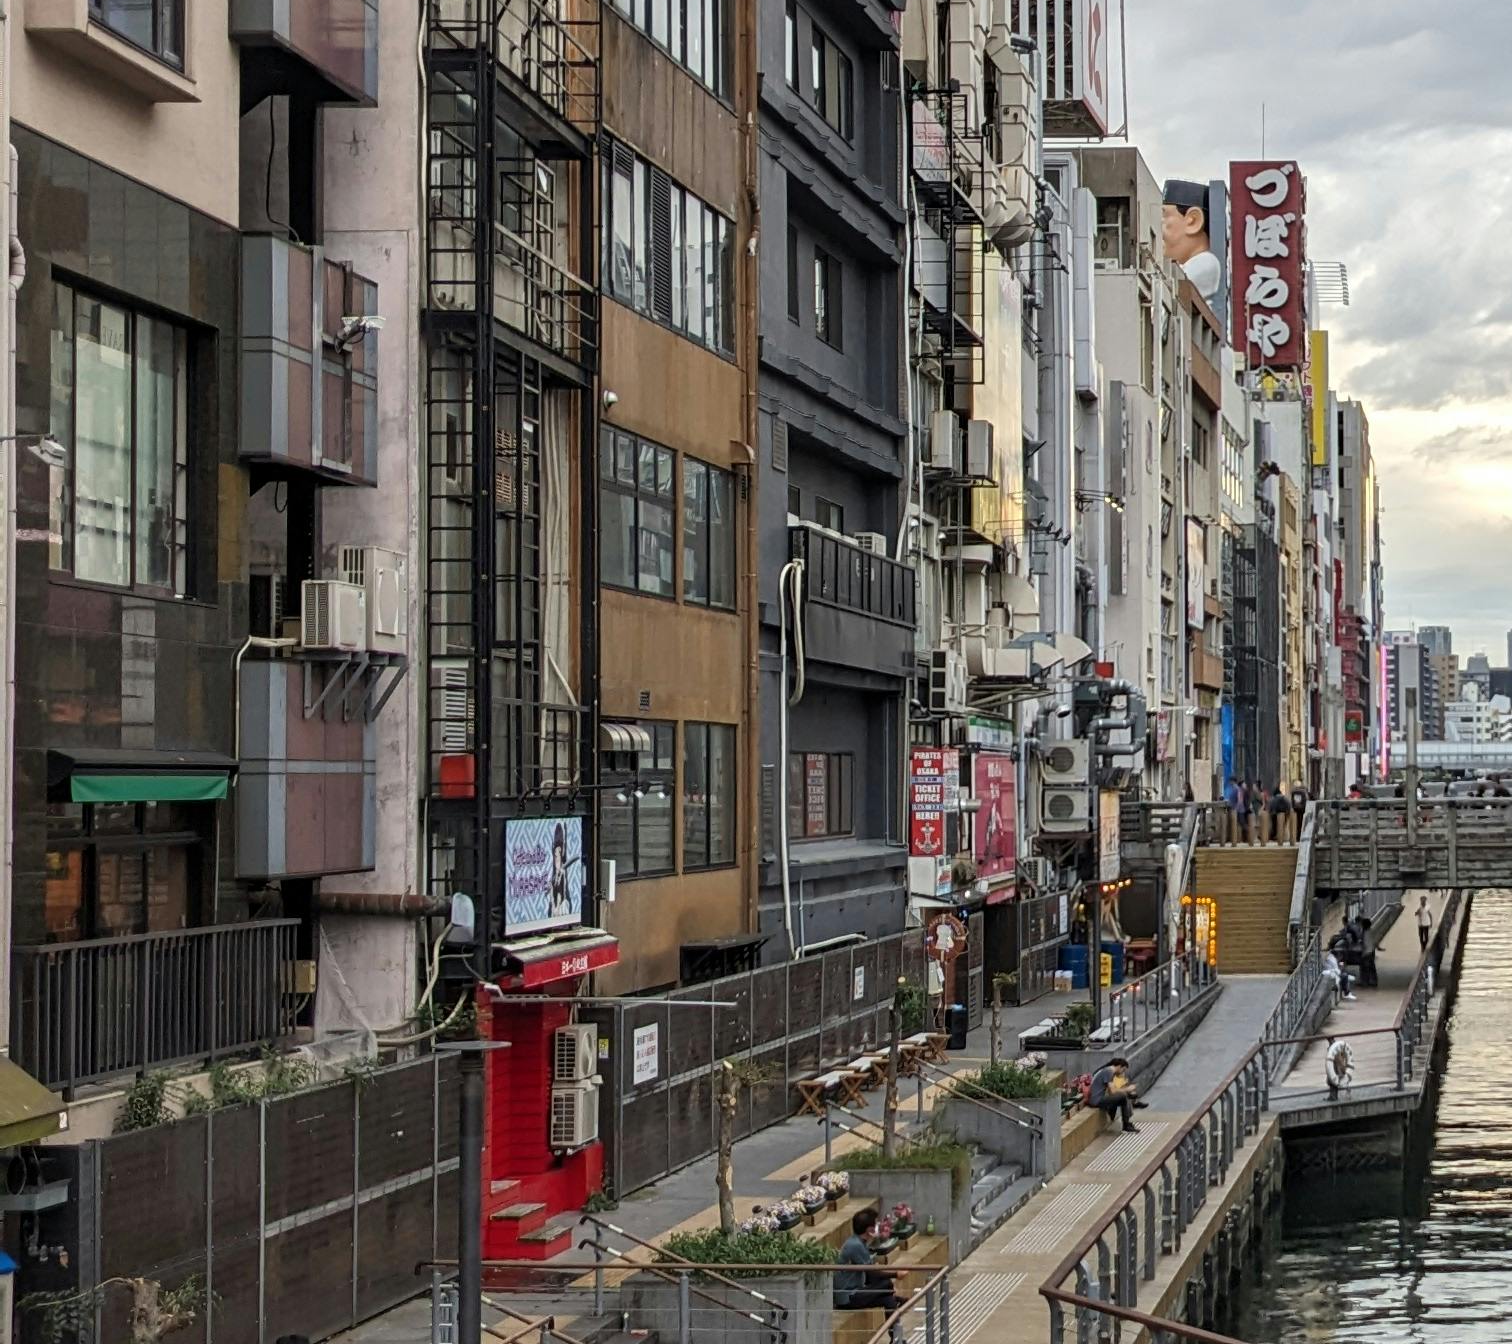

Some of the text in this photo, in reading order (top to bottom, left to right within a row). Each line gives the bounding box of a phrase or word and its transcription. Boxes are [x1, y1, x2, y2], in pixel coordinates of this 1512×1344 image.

[1244, 163, 1297, 358] づぼらや
[915, 785, 941, 793] TICKET
[915, 794, 940, 802] OFFICE
